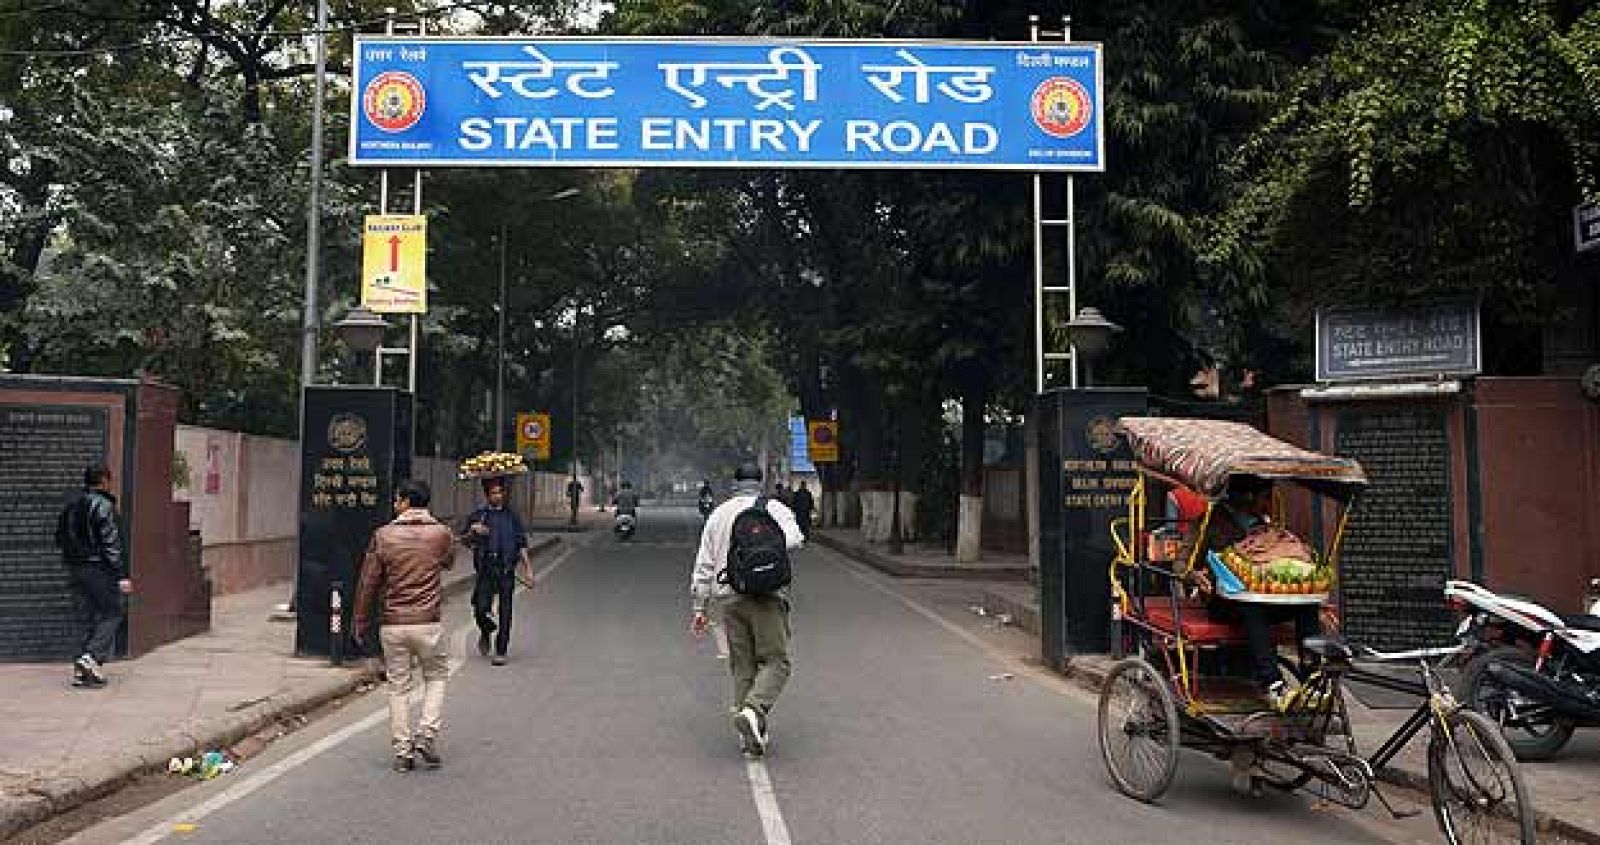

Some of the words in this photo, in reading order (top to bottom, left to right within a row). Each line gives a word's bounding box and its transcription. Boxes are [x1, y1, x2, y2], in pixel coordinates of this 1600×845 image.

[463, 45, 620, 98] स्टेट
[657, 47, 823, 111] एन्ट्री
[862, 49, 997, 104] रोड
[459, 117, 619, 150] STATE
[641, 118, 822, 152] ENTRY
[846, 119, 999, 155] ROAD
[1333, 342, 1373, 359] STATE
